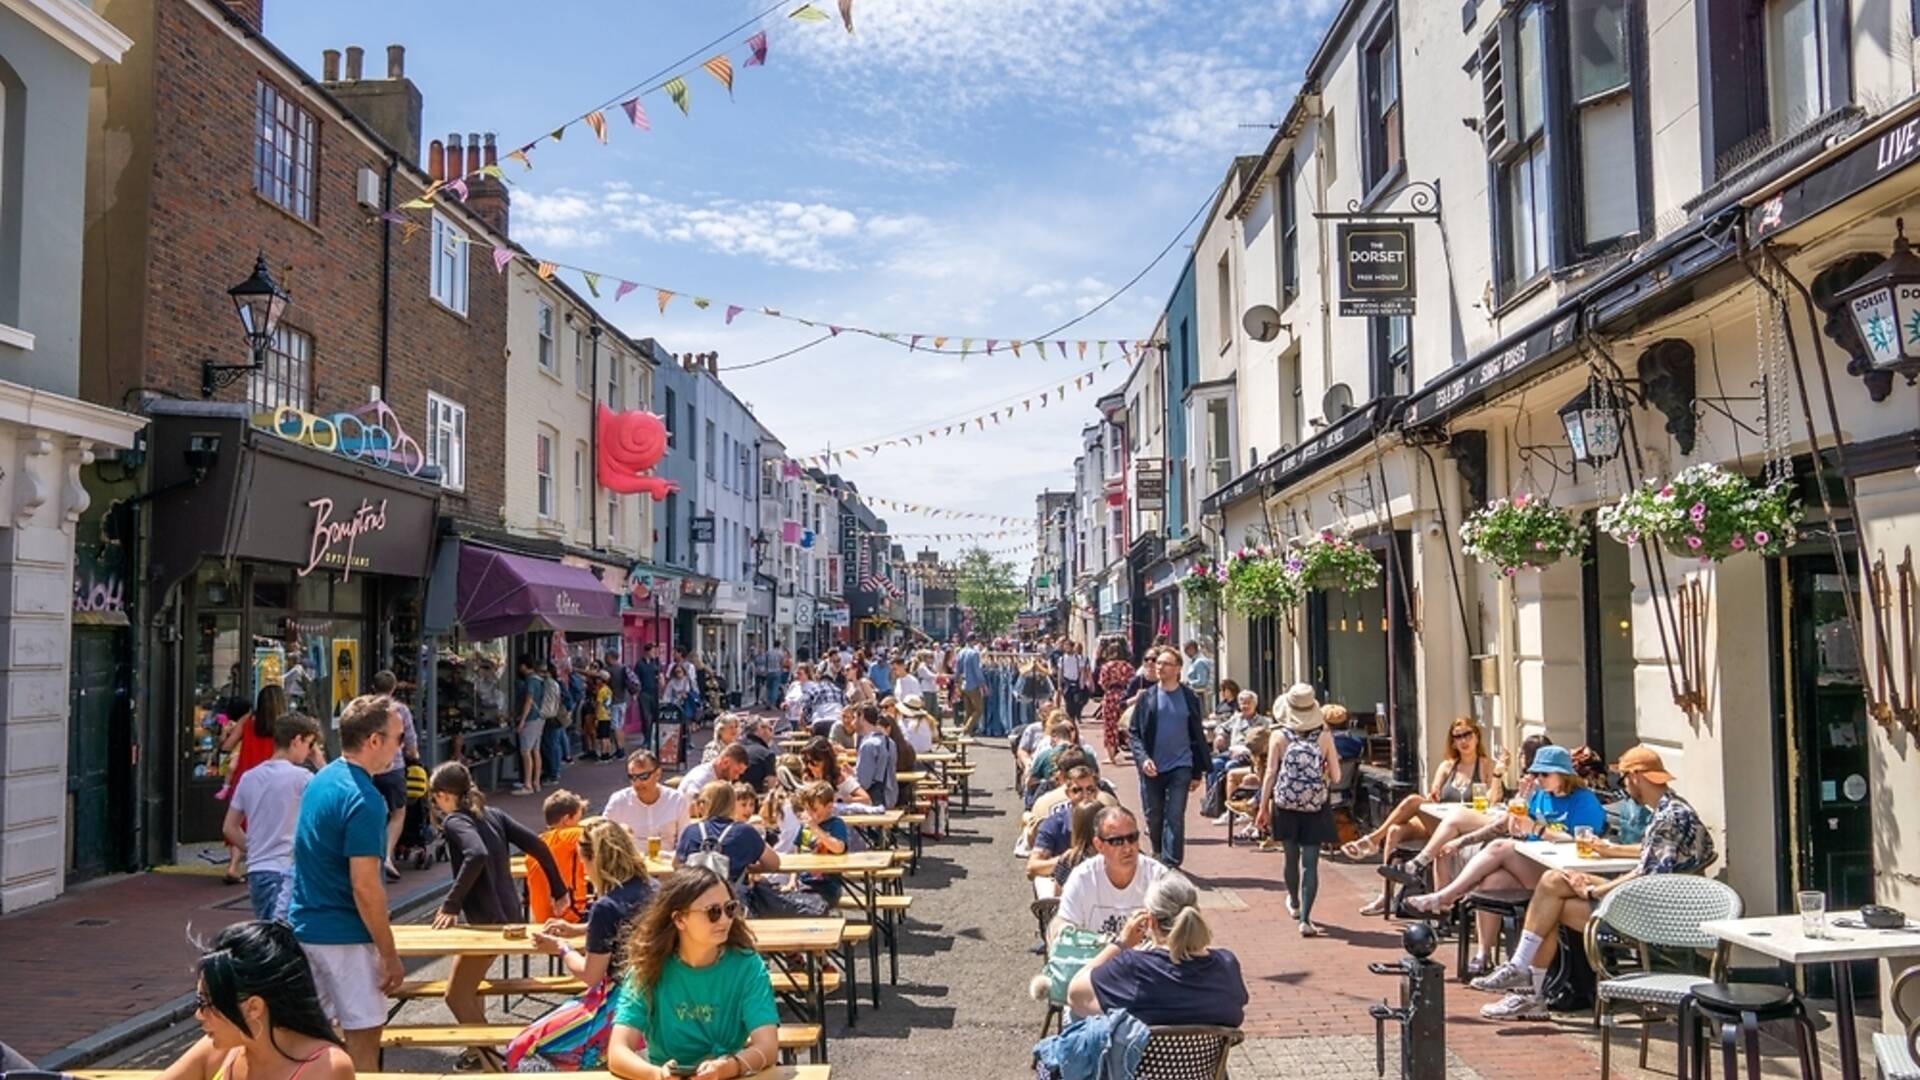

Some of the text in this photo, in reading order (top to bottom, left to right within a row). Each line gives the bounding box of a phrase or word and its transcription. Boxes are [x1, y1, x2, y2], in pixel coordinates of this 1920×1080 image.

[1876, 118, 1919, 171] LIVE
[1350, 250, 1405, 263] DORSET
[1854, 290, 1888, 312] DORSET
[325, 552, 369, 567] OPTIIANS
